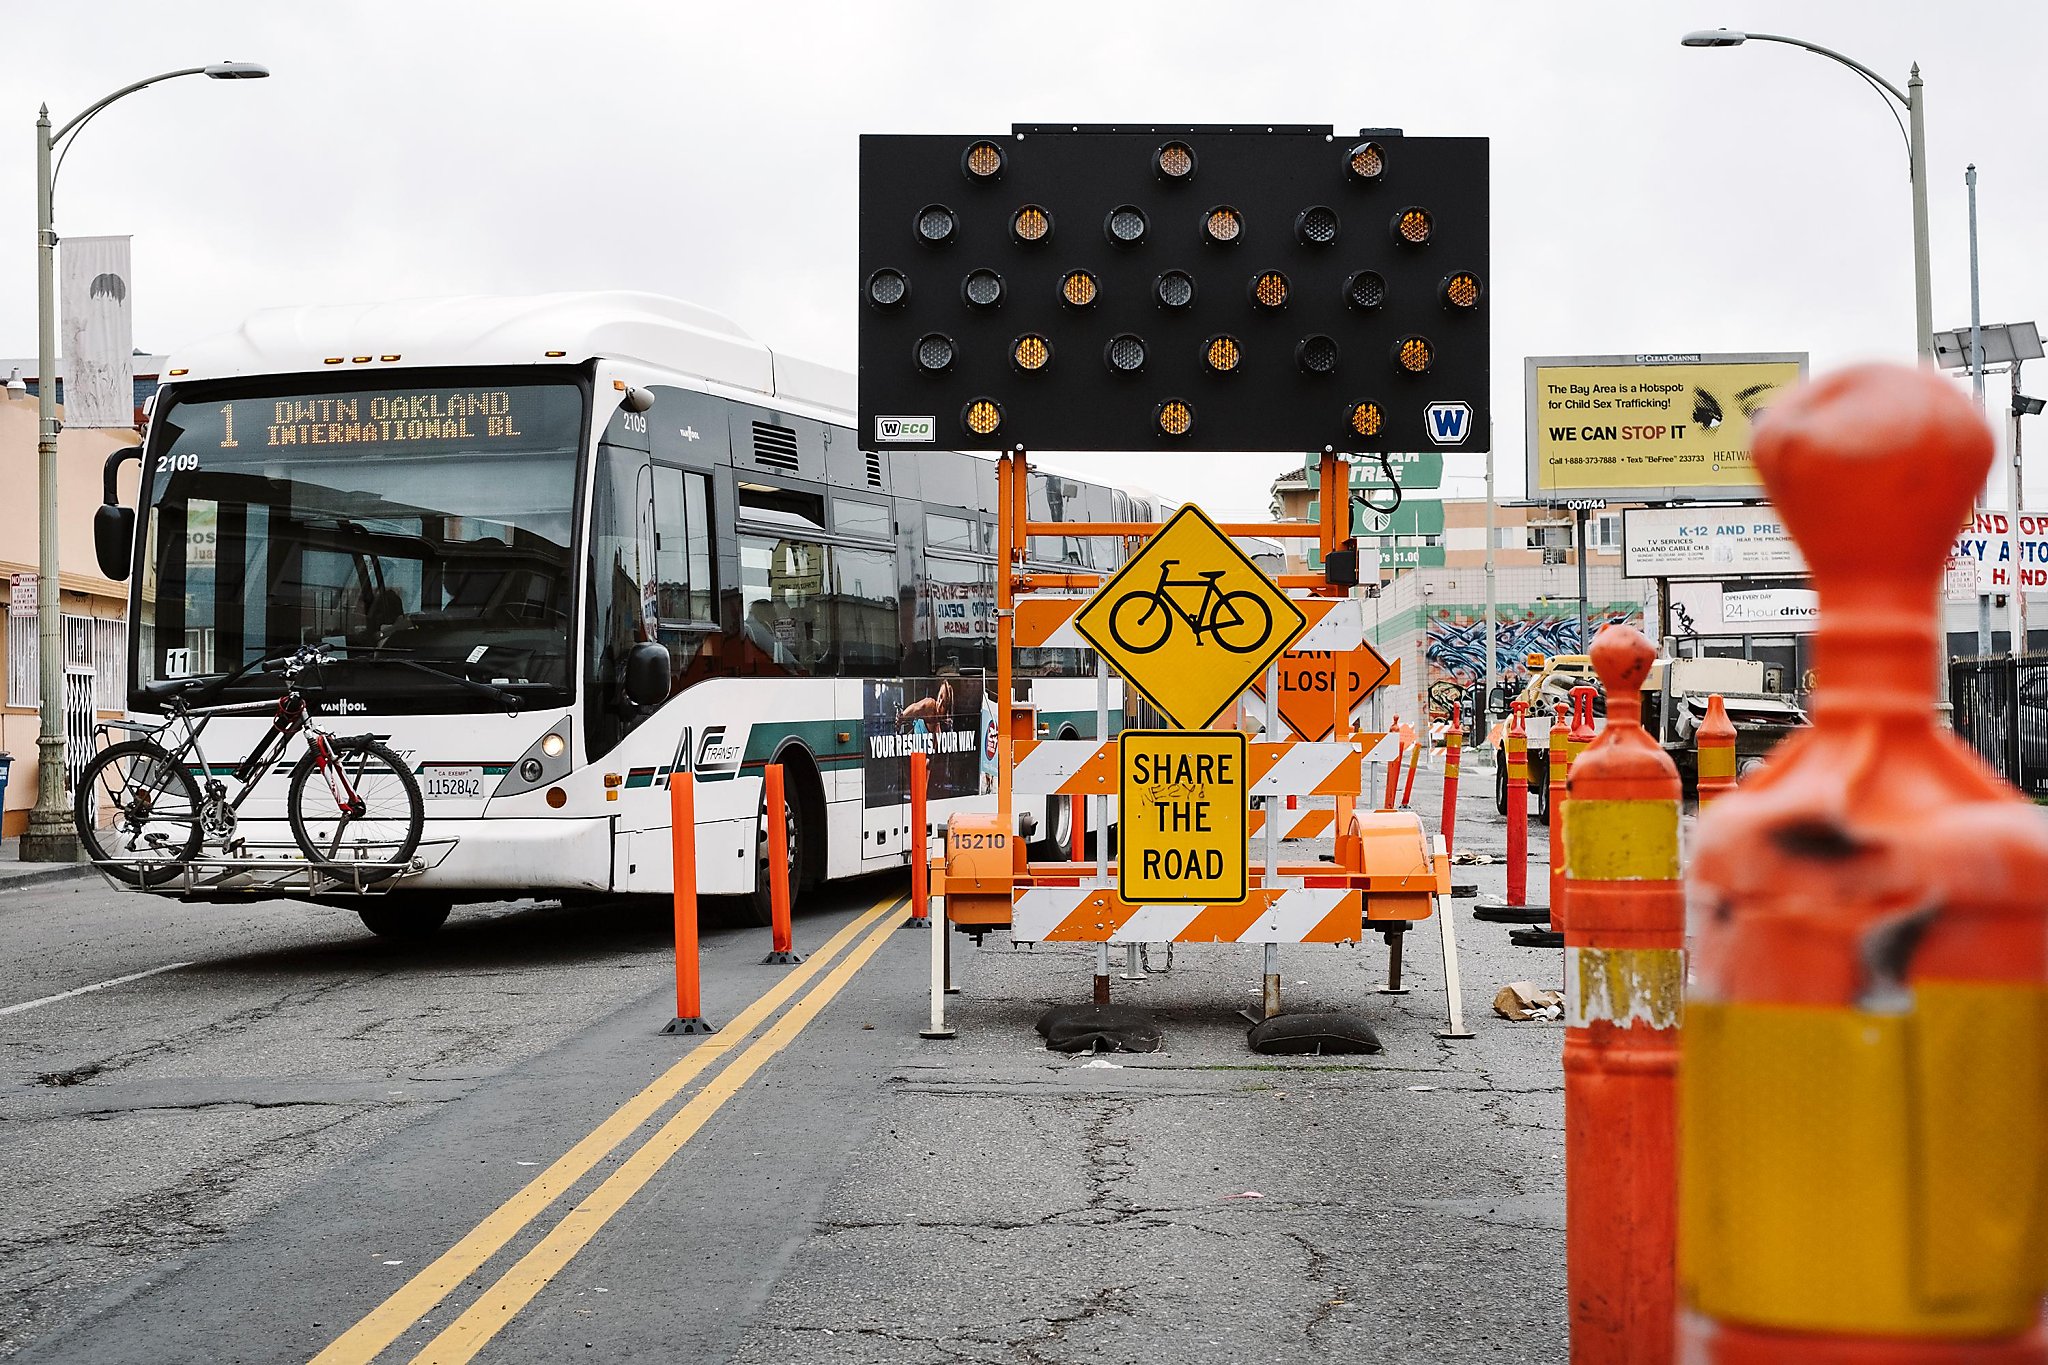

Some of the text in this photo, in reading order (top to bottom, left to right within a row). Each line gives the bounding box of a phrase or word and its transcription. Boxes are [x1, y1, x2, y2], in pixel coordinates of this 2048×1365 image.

[1548, 385, 1567, 394] The
[1570, 384, 1590, 396] Bay
[1593, 384, 1617, 393] Area
[1619, 383, 1628, 393] is
[1639, 383, 1684, 395] Hotspot
[275, 391, 510, 425] DWTN OAKLAND
[1548, 398, 1671, 410] for Child Sex Trafficking!
[220, 403, 238, 447] 1
[267, 415, 521, 447] INTERNATIONAL BL
[623, 412, 646, 434] 2109
[1432, 409, 1465, 437] W
[1549, 425, 1687, 441] WE CAN STOP IT
[156, 453, 199, 473] 2109
[1549, 457, 1563, 465] Call
[1679, 455, 1705, 463] 233733
[1713, 450, 1752, 461] HEATWA
[1349, 465, 1404, 482] TREE
[1567, 499, 1606, 510] 001744
[1680, 526, 1708, 536] K-12
[1716, 525, 1745, 535] AND
[1998, 540, 2048, 562] ATO
[11, 575, 19, 585] NO
[1992, 568, 2047, 586] HND
[1725, 603, 1743, 618] 24
[1747, 608, 1779, 618] hour
[168, 651, 188, 673] 11
[1278, 670, 1361, 692] LOSD
[706, 746, 740, 760] TRANSIT
[869, 735, 895, 759] YOUR
[896, 732, 936, 757] RESULTS.
[936, 731, 958, 754] YOUR
[958, 730, 977, 752] WAY.
[1132, 753, 1234, 785] SHARE
[428, 779, 480, 795] 1152842
[1154, 801, 1212, 832] THE
[953, 833, 1006, 850] 15210
[1143, 848, 1224, 880] ROAD
